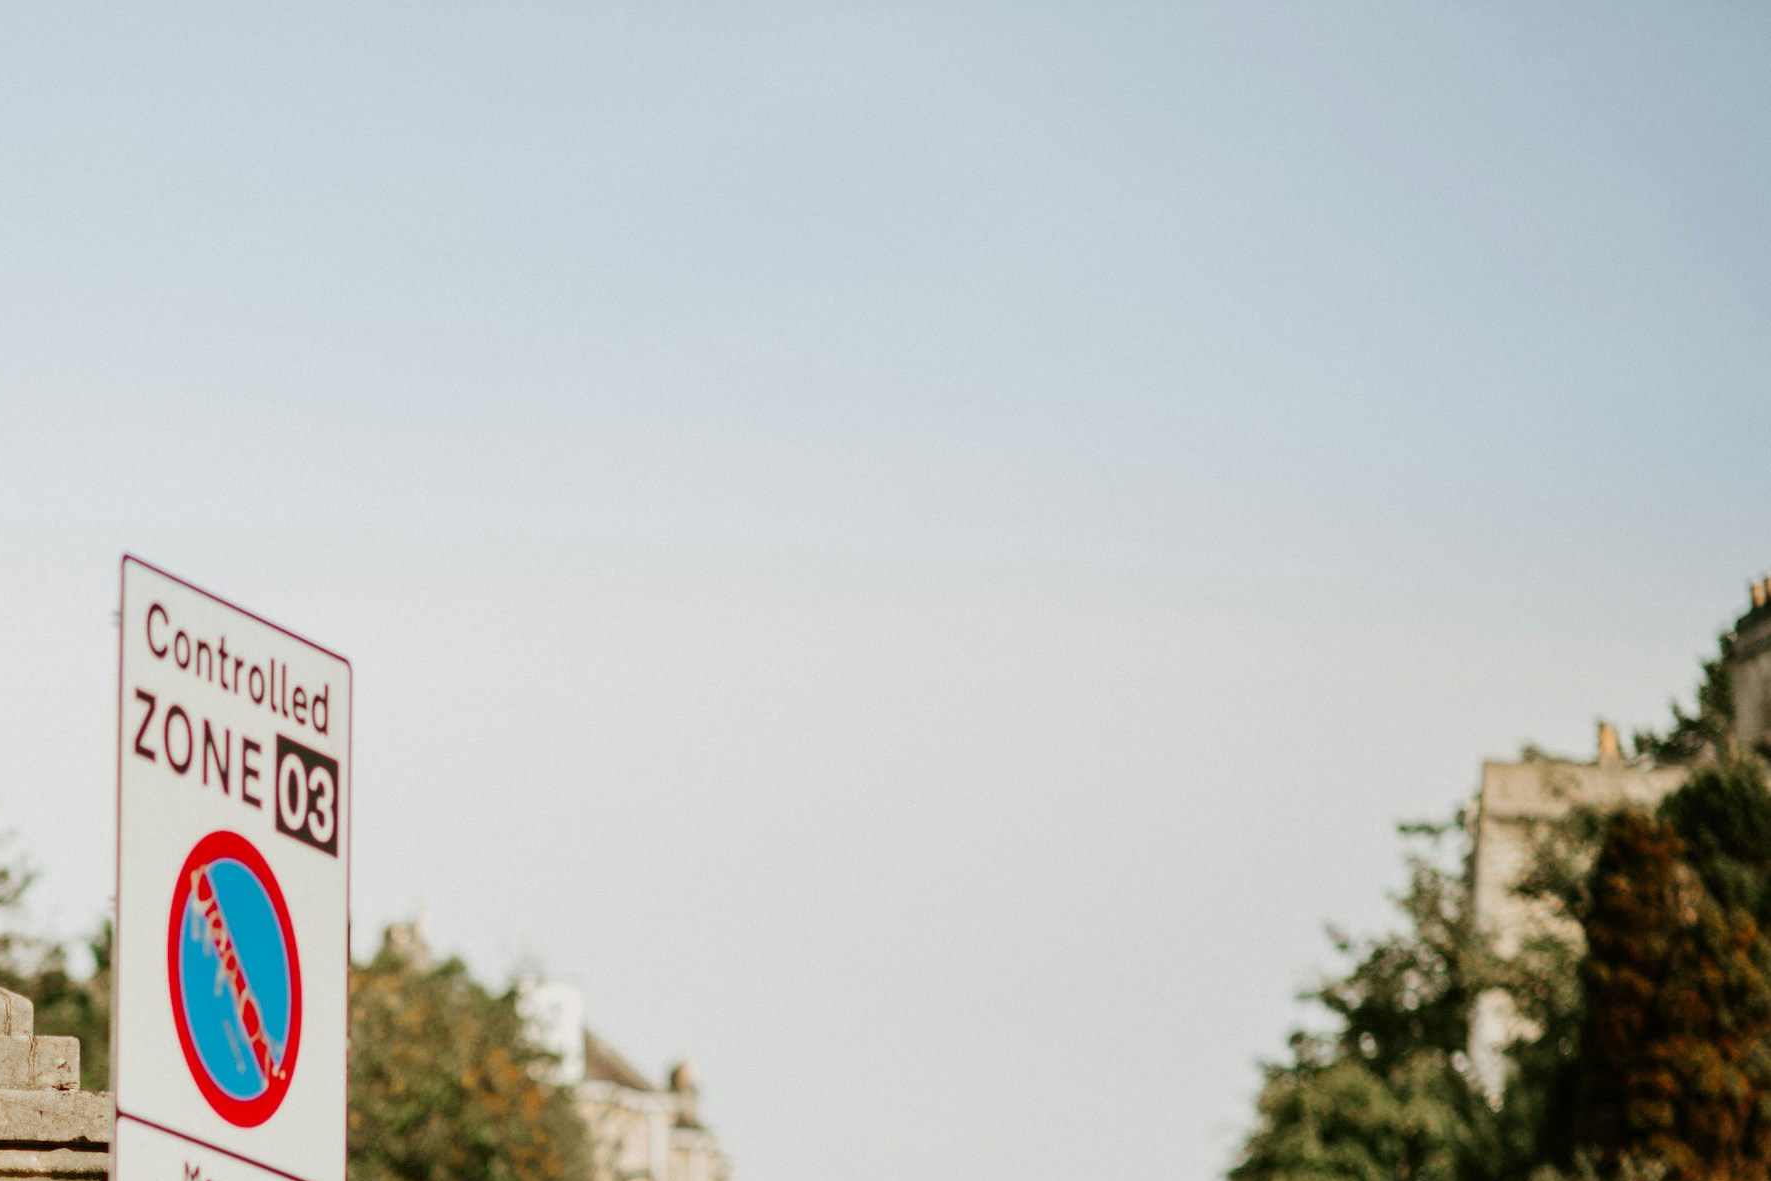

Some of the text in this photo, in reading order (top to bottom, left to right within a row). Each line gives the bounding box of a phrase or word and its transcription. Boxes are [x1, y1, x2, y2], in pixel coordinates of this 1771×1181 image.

[147, 602, 329, 736] Controlled
[134, 687, 335, 844] ZONE 03
